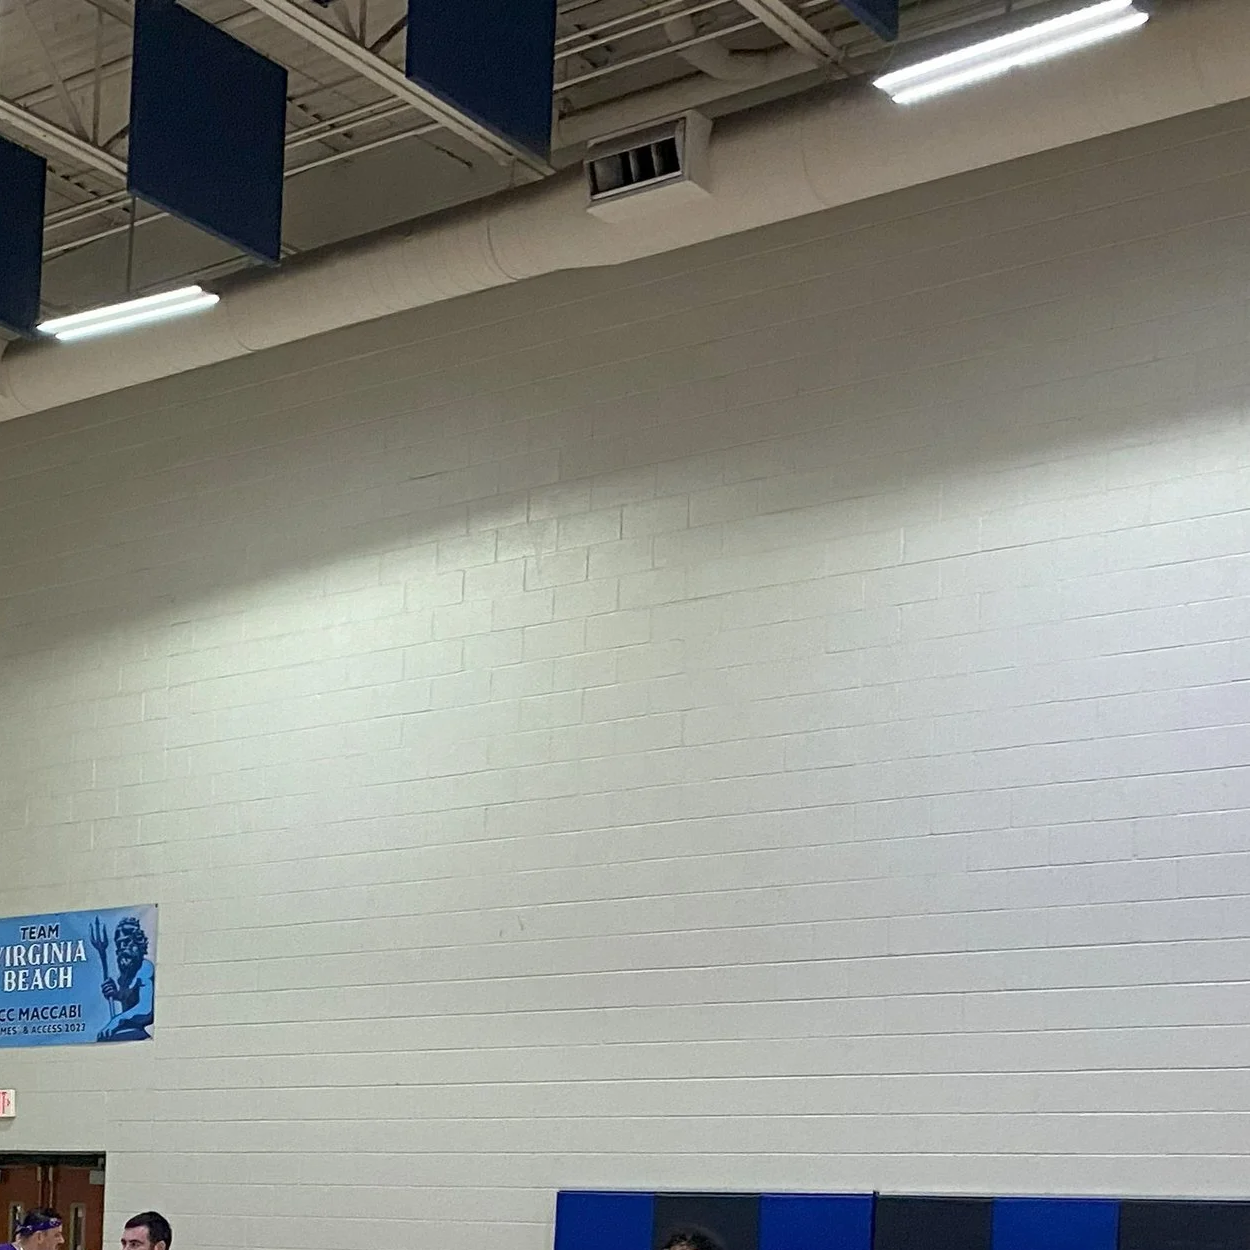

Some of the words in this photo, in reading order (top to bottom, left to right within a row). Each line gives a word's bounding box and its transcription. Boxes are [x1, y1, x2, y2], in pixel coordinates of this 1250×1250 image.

[21, 923, 60, 941] TEAM
[3, 966, 73, 992] BEACH
[19, 1005, 82, 1021] MACCABI
[32, 1024, 62, 1034] ACCESS
[65, 1022, 86, 1033] 2023
